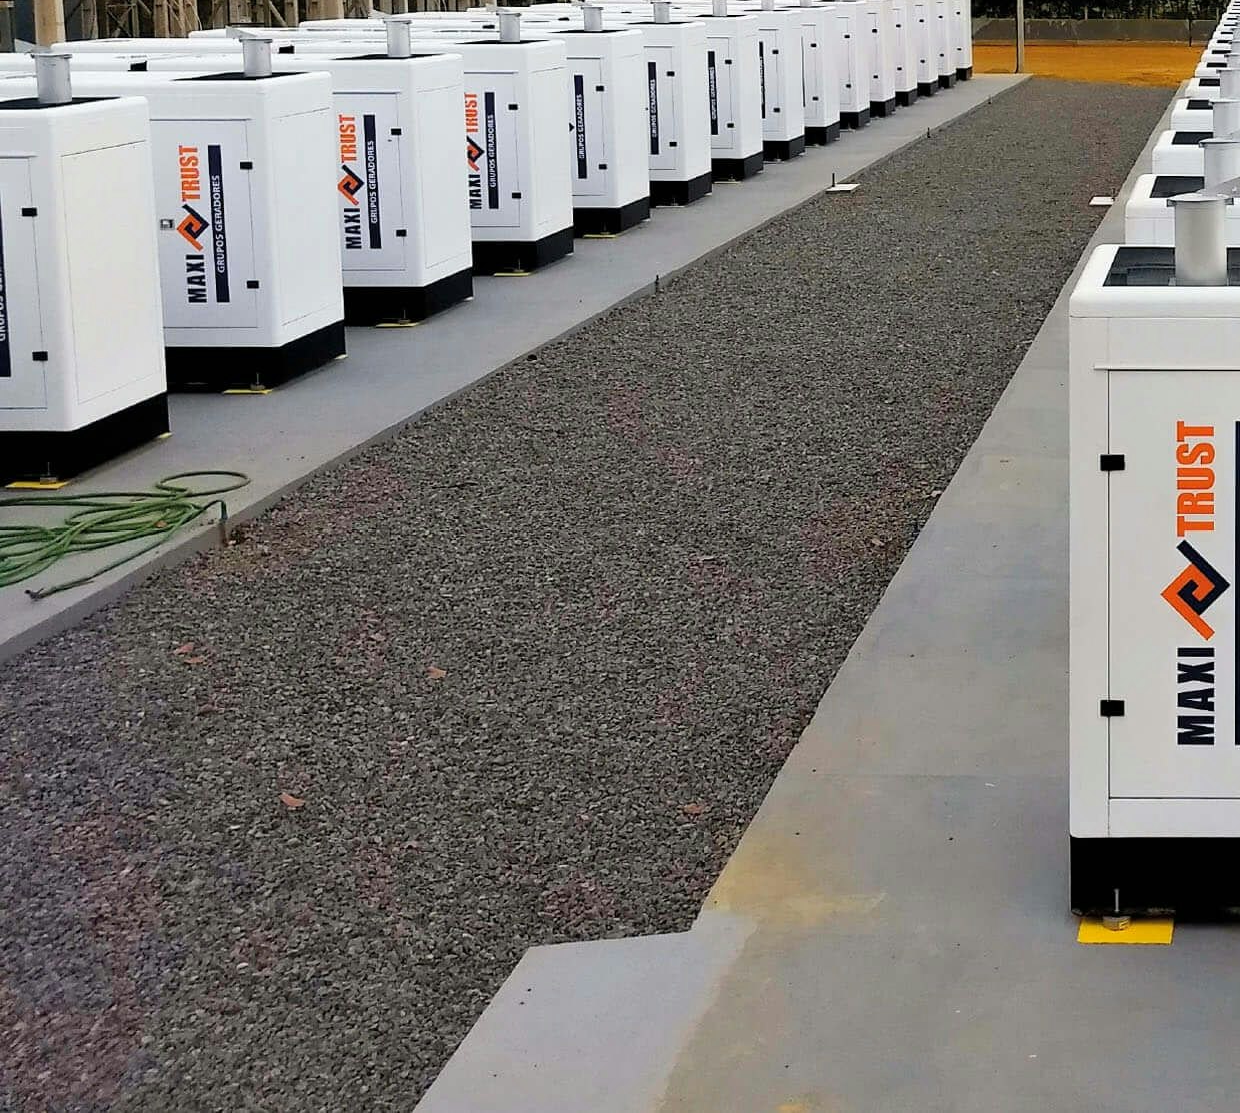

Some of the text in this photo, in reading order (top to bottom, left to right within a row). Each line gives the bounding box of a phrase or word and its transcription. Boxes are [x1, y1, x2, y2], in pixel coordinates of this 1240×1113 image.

[339, 114, 362, 249] MAXI TRUST
[367, 140, 378, 224] GRUPOS GERADORES
[464, 92, 482, 210] MAXI TRUST
[487, 114, 497, 188] GRUPOS GERADORES
[178, 145, 207, 303] MAXI TRUST
[211, 174, 225, 274] GRUPOS GERADORES
[1176, 420, 1216, 746] MAXI TRUST
